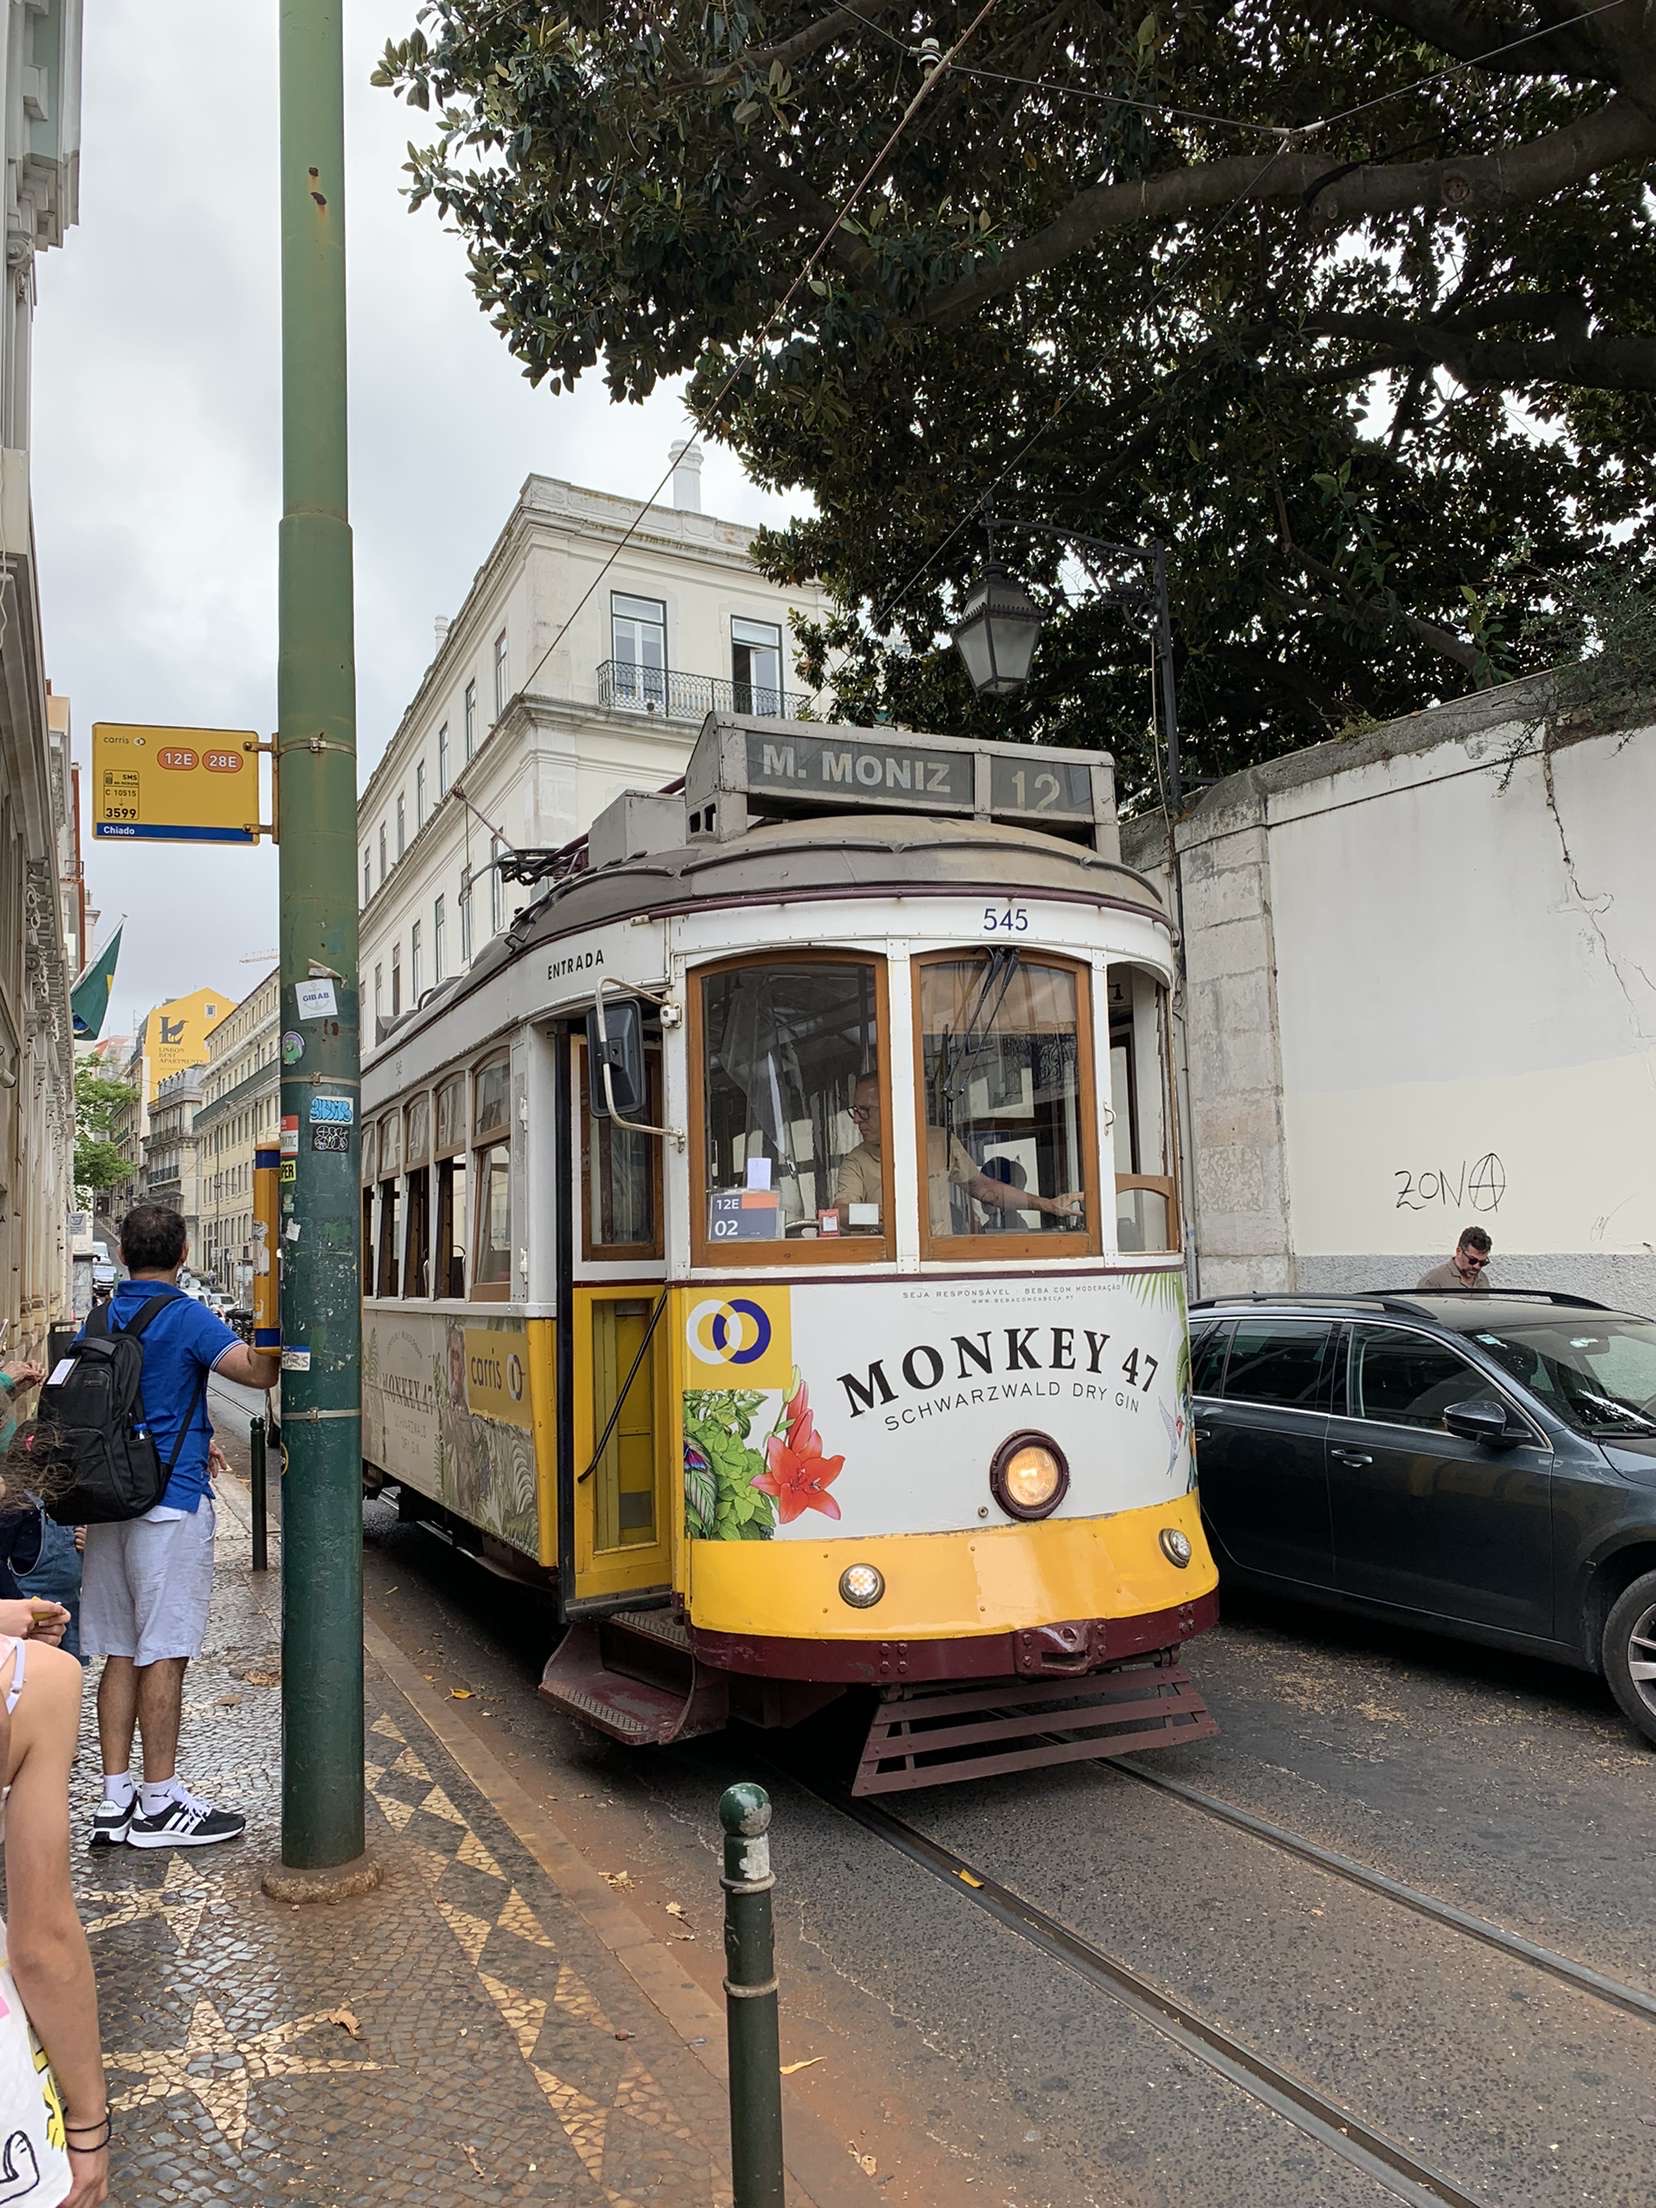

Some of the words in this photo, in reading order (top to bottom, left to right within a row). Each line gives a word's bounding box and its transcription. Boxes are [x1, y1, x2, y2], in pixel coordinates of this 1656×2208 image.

[103, 736, 130, 744] carris
[164, 752, 193, 766] 12E
[209, 755, 237, 768] 28E
[763, 744, 806, 779] M.
[822, 751, 951, 794] MONIZ
[1011, 770, 1061, 812] 12
[106, 807, 137, 818] 3599
[103, 826, 135, 835] Chiado
[983, 908, 1029, 931] 545
[547, 949, 604, 980] ENTRADA
[716, 1199, 740, 1210] 12E
[714, 1220, 738, 1236] 02
[902, 1290, 930, 1299] SEJA
[935, 1287, 1011, 1298] RESPONSÁVEL
[1024, 1286, 1049, 1295] BEBA
[1054, 1285, 1072, 1294] COM
[1076, 1283, 1121, 1293] MODERAÇÃO
[471, 1347, 502, 1390] carris
[836, 1327, 1111, 1418] MONKEY
[1121, 1347, 1159, 1393] 47
[884, 1381, 1061, 1431] SCHWARZWALD
[1073, 1383, 1108, 1402] DRY
[1115, 1392, 1140, 1413] GIN
